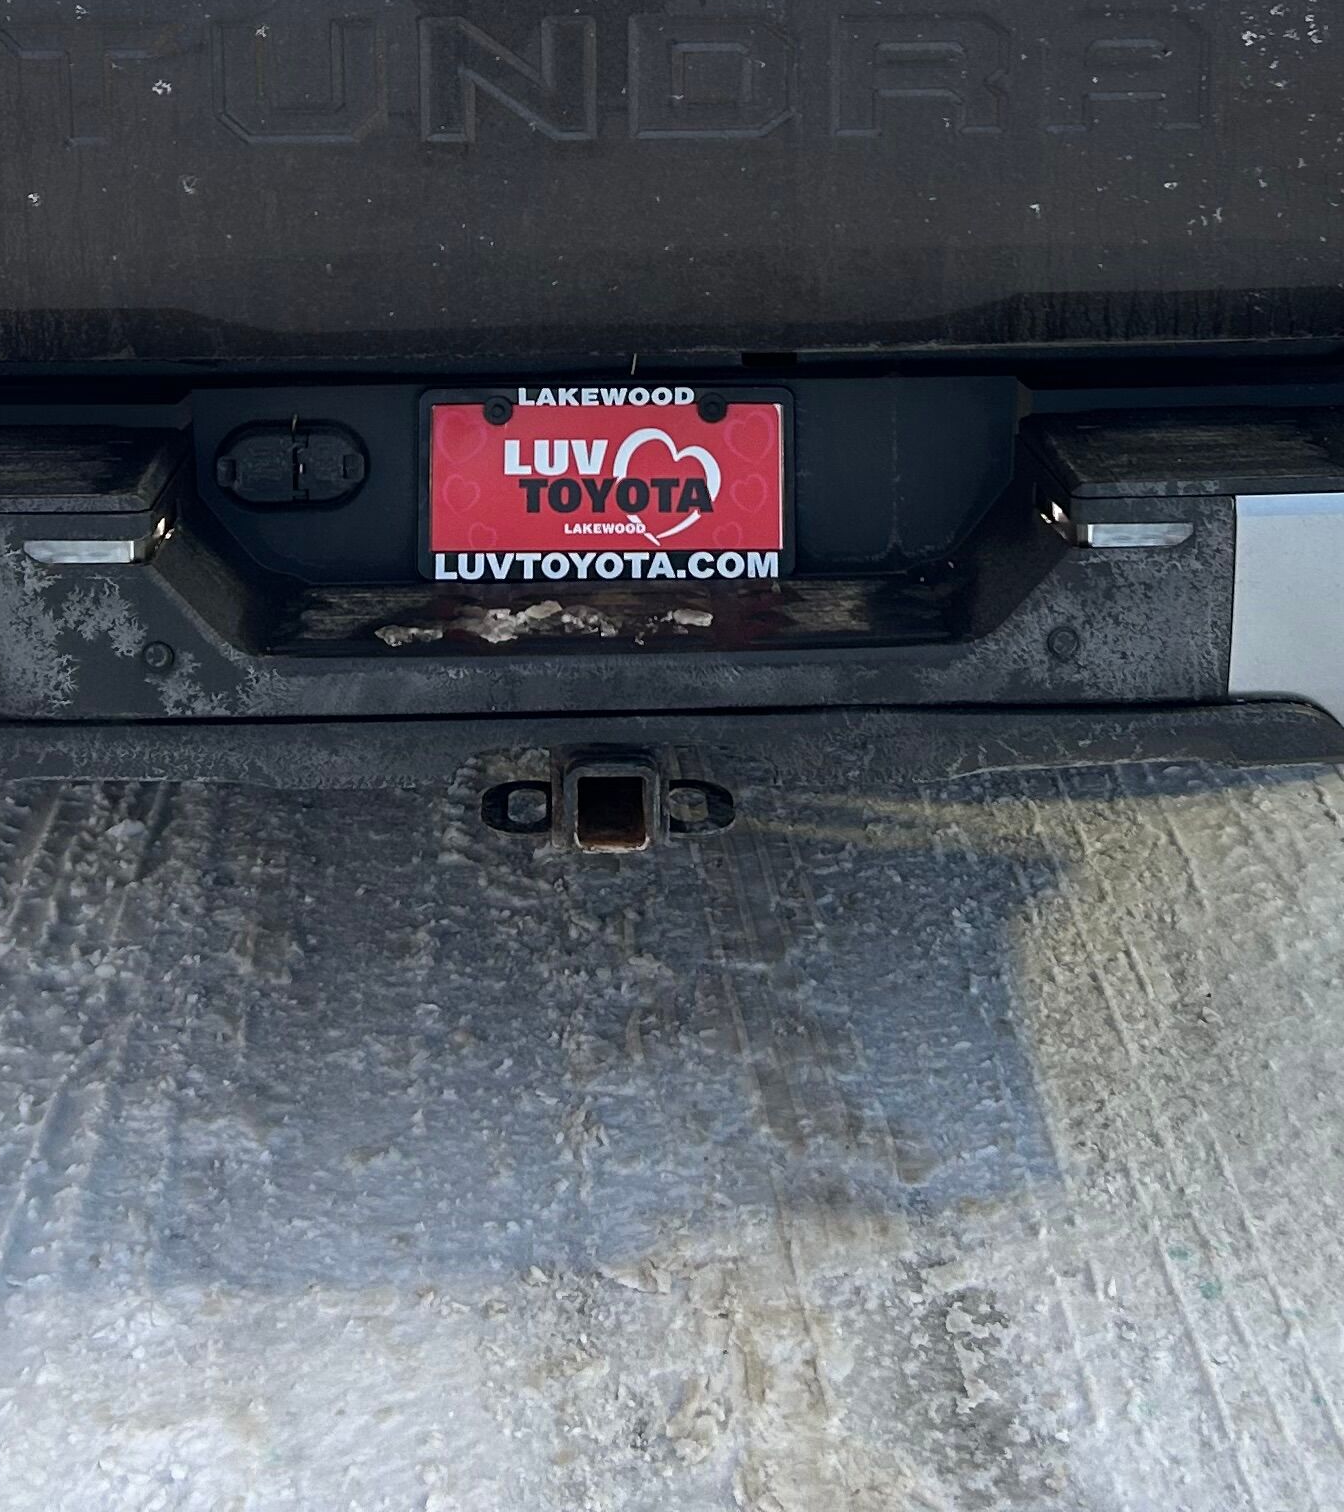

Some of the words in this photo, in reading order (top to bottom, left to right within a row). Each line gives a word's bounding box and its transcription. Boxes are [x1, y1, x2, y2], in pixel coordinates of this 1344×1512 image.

[517, 386, 695, 407] LAKEWOOD
[504, 439, 609, 477] LUV
[519, 477, 715, 514] TOYOTA
[564, 522, 647, 535] LAKEWOOD
[434, 551, 779, 581] LUVTOYOTA.COM
